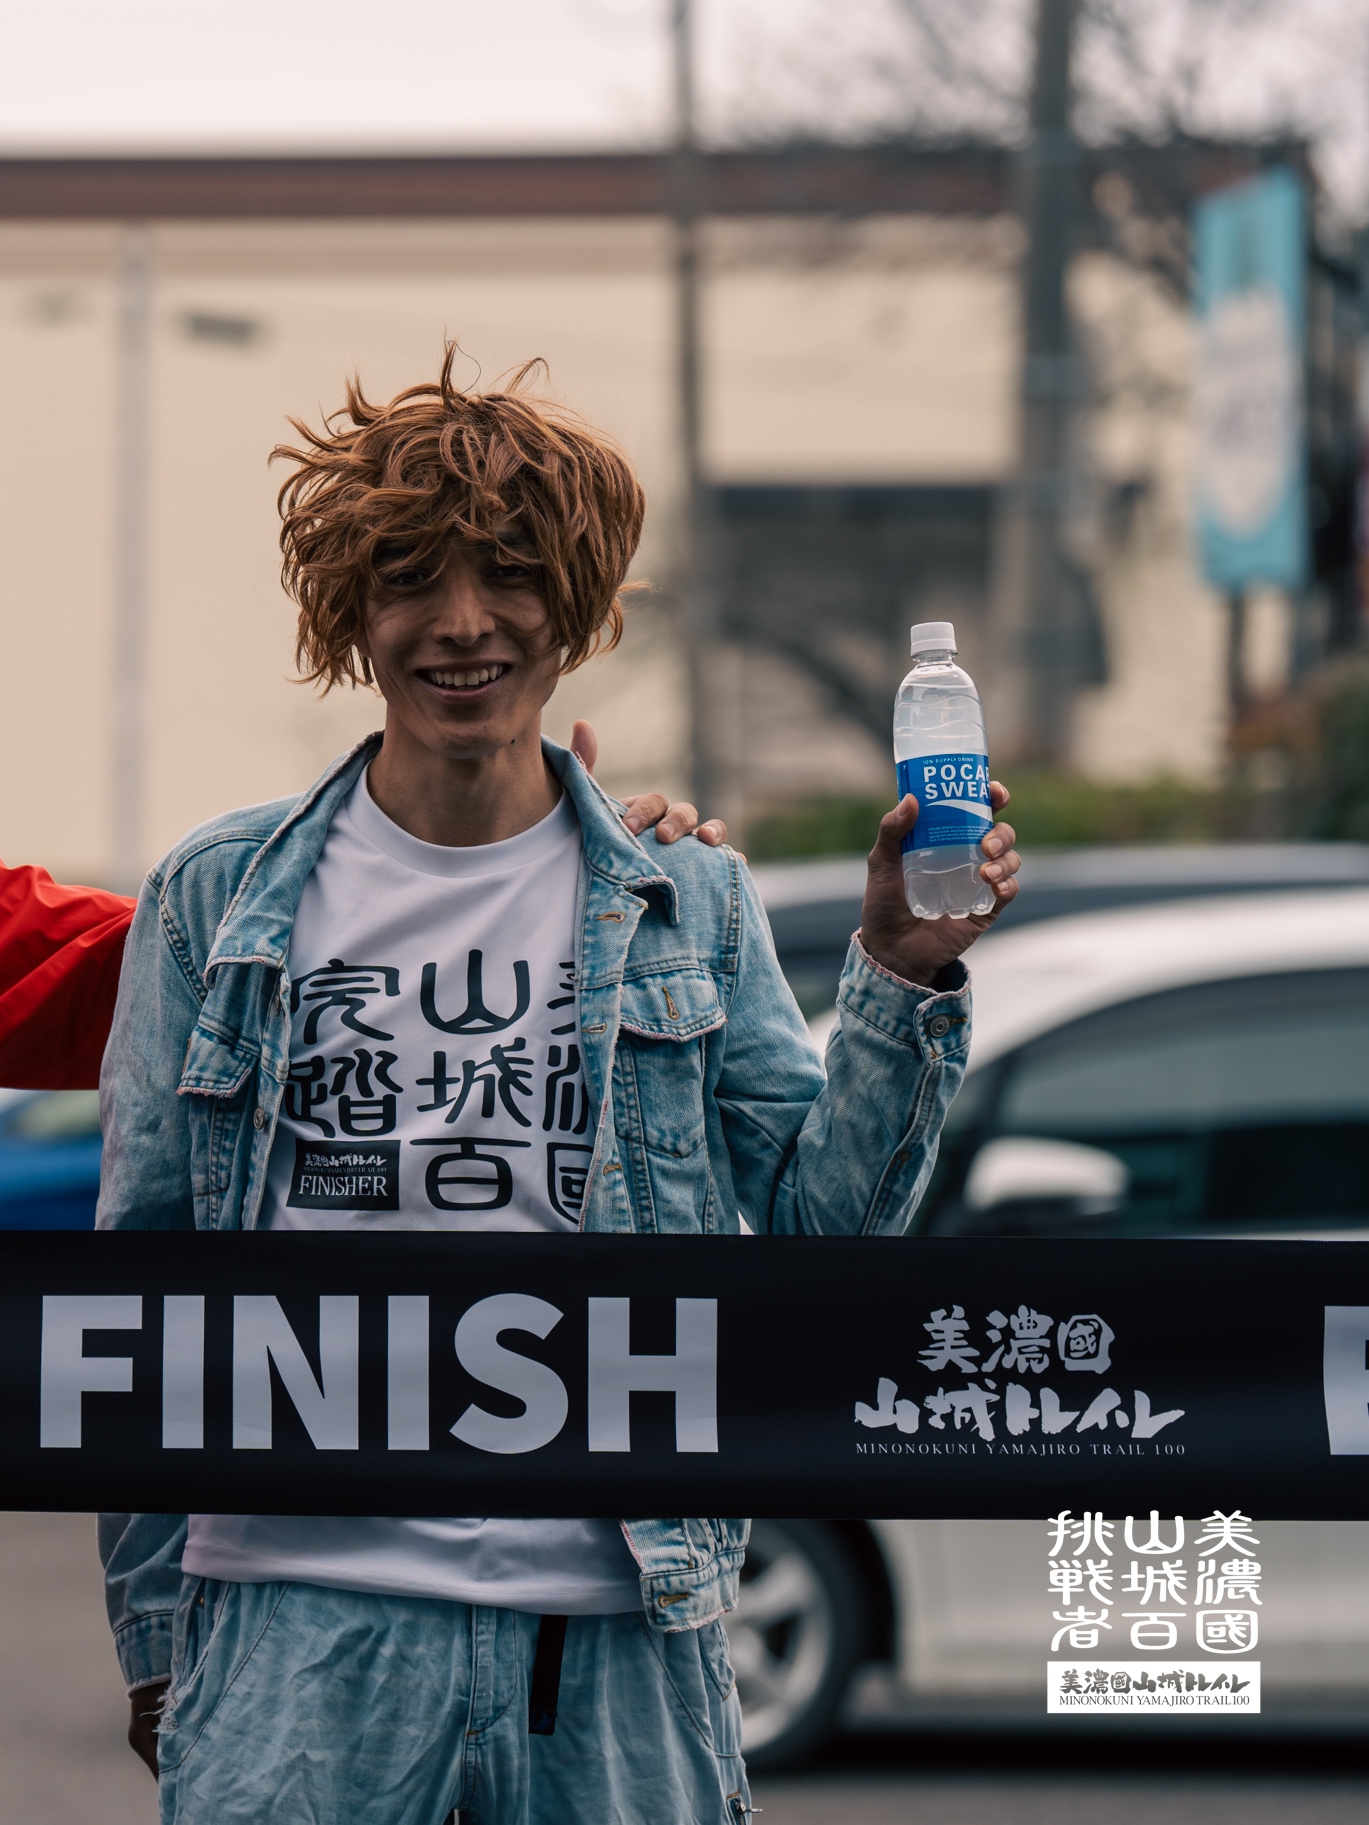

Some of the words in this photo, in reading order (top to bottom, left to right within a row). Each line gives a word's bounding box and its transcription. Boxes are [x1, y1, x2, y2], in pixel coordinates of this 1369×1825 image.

[298, 1174, 388, 1197] FINISHER
[39, 1292, 719, 1455] FINISH
[855, 1442, 977, 1455] MINONOKUNI
[986, 1443, 1081, 1457] YAMAJIRO
[1089, 1443, 1146, 1456] TRAIL
[1154, 1443, 1186, 1456] 100
